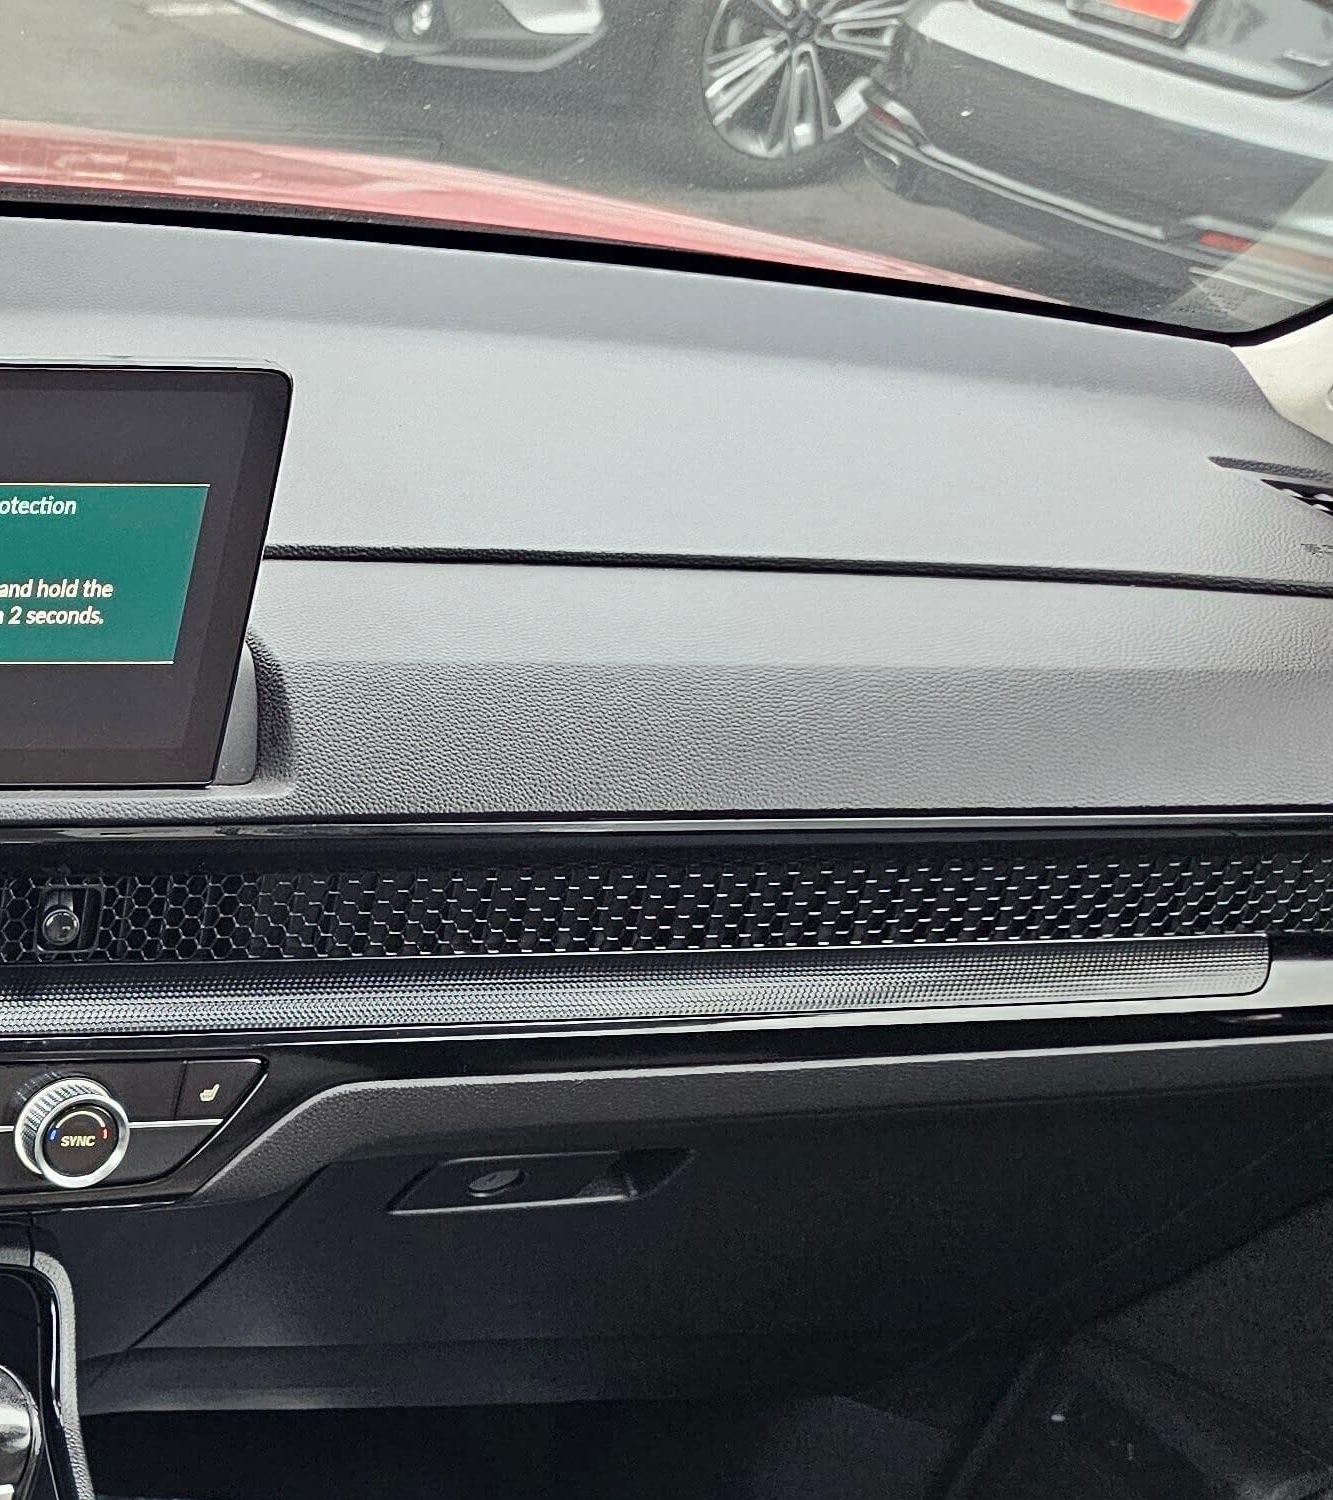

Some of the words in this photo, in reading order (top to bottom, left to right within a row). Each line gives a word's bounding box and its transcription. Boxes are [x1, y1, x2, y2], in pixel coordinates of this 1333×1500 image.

[36, 579, 80, 598] hold
[83, 579, 114, 598] the
[8, 606, 21, 625] 2
[26, 606, 105, 625] seconds.
[61, 1135, 95, 1148] SYNC
